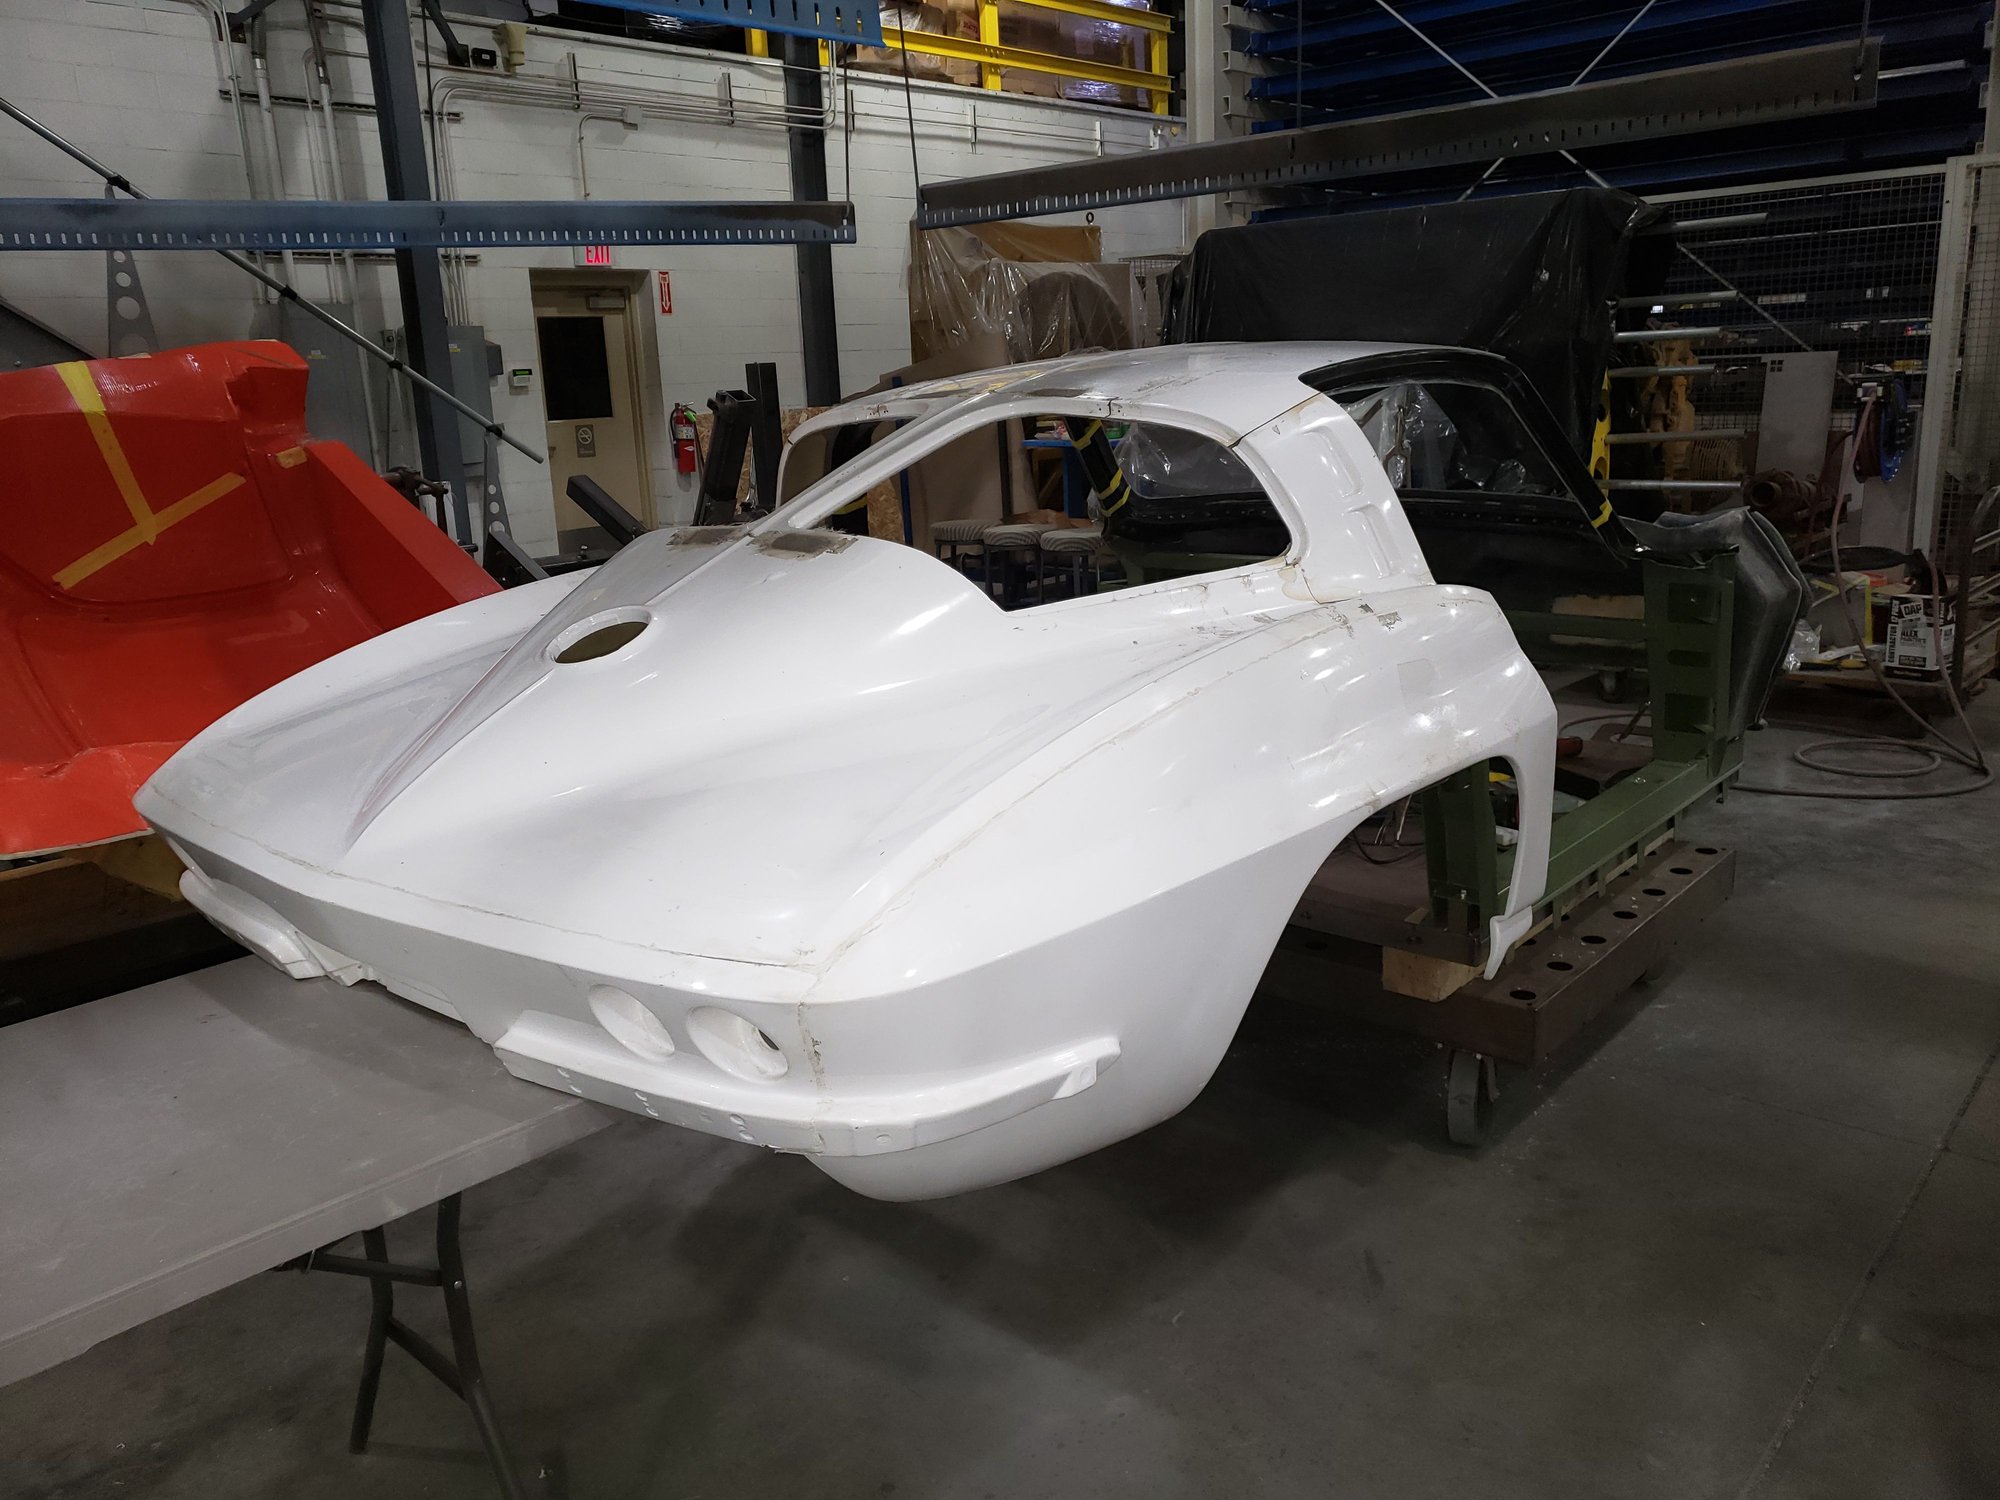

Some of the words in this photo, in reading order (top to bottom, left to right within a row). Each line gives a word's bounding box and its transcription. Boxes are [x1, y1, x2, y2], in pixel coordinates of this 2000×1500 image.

[586, 245, 610, 264] EXIT
[1904, 604, 1922, 615] DAP
[1888, 626, 1897, 663] CONTRACTOR
